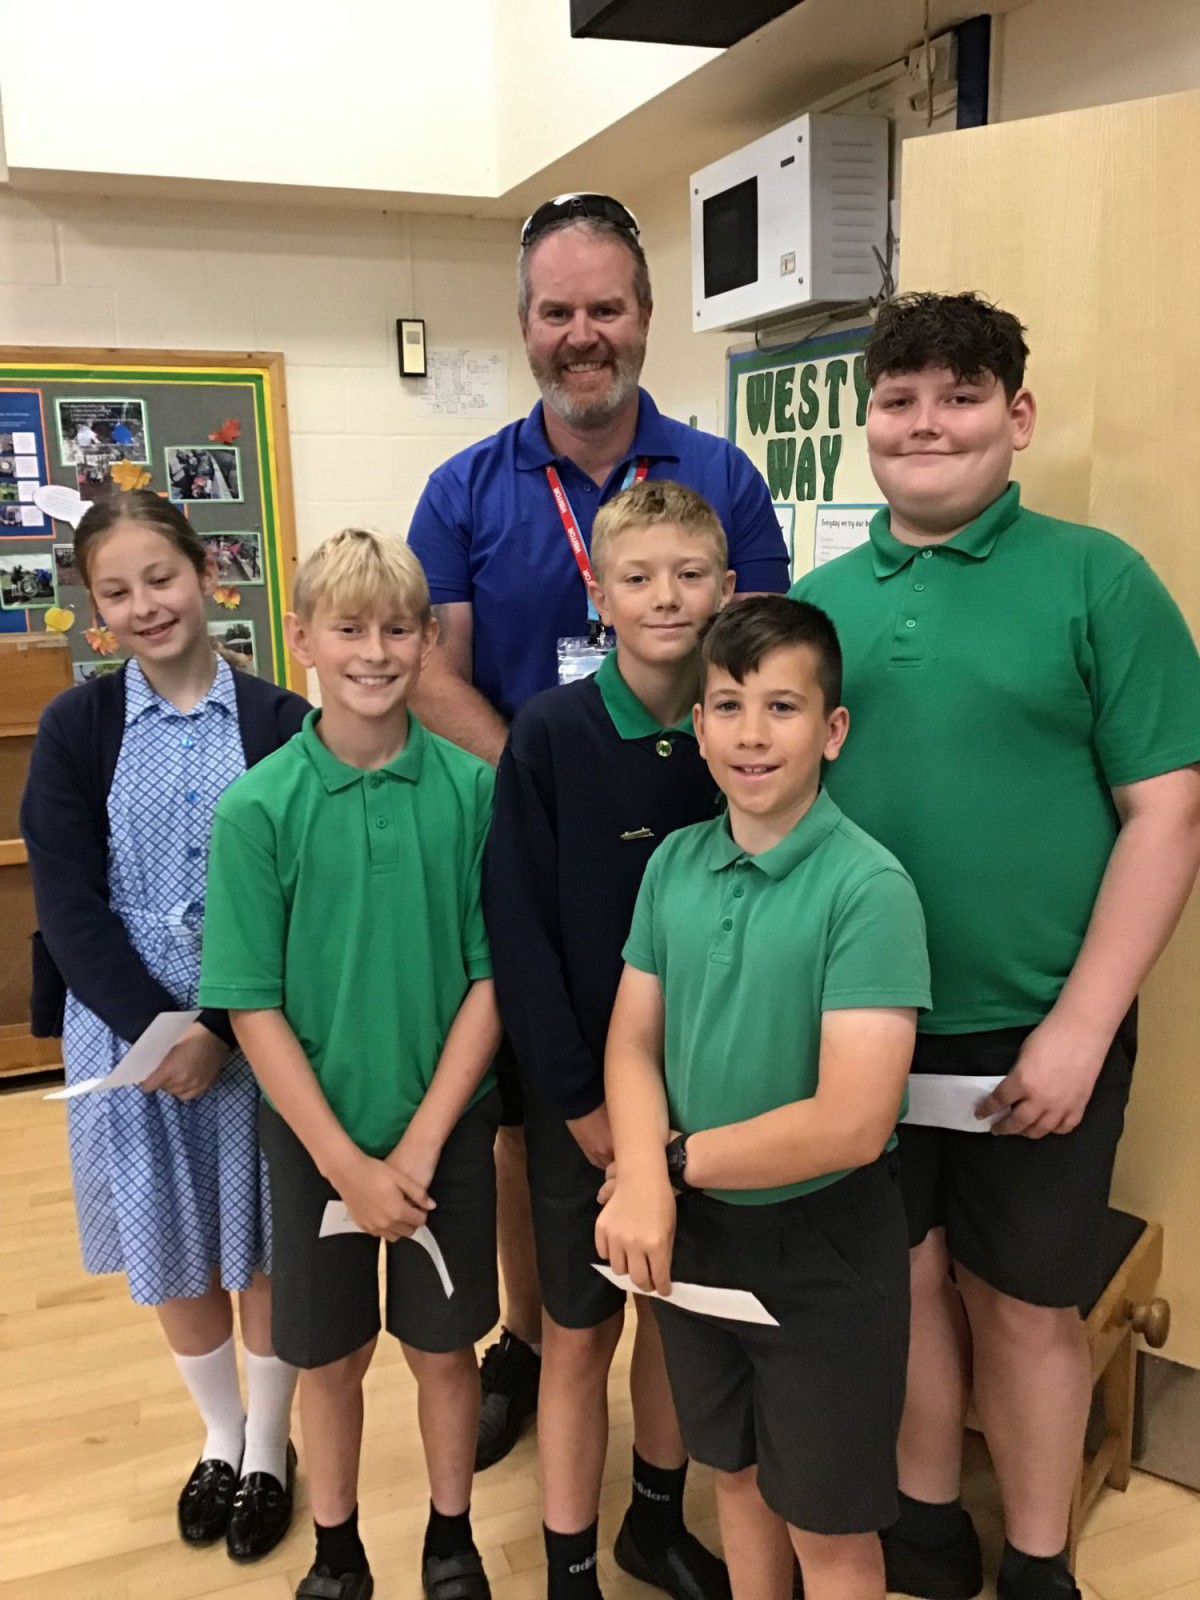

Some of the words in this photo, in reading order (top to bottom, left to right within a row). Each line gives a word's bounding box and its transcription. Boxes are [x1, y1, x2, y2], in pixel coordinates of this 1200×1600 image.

[746, 355, 872, 436] WESTY
[767, 434, 842, 501] WAY
[553, 486, 567, 514] VISITOR
[821, 518, 840, 529] Everyday
[567, 526, 581, 554] VISITOR
[633, 1479, 670, 1501] didas
